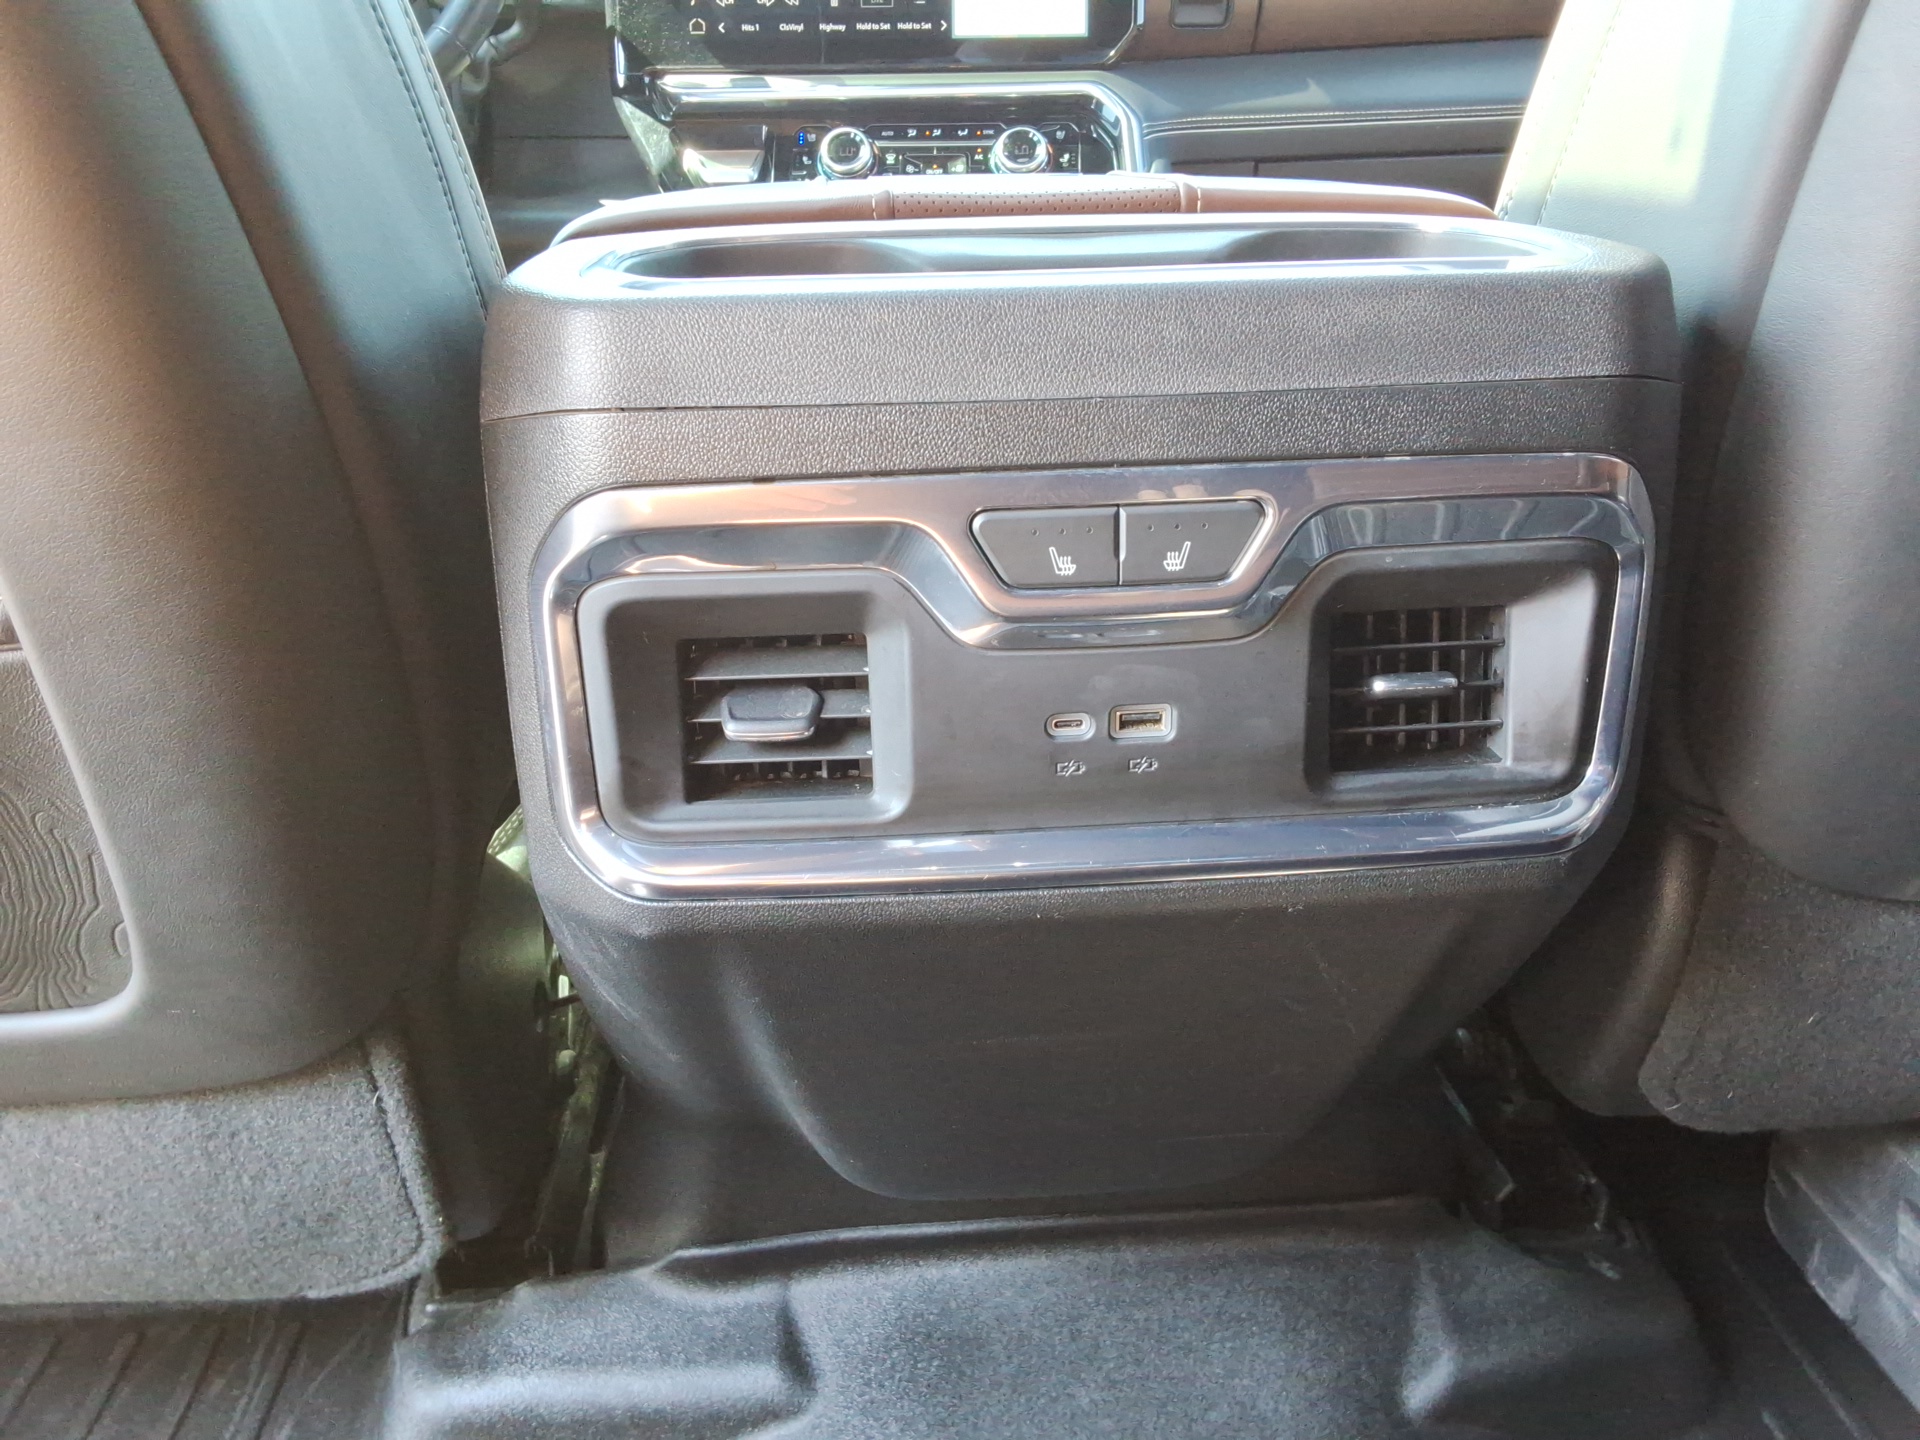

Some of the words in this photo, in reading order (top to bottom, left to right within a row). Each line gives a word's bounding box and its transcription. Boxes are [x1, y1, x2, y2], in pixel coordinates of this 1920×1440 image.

[819, 23, 846, 32] Highway
[856, 22, 872, 30] Hold
[897, 22, 913, 30] Hold
[913, 22, 920, 30] to
[920, 22, 932, 30] Set
